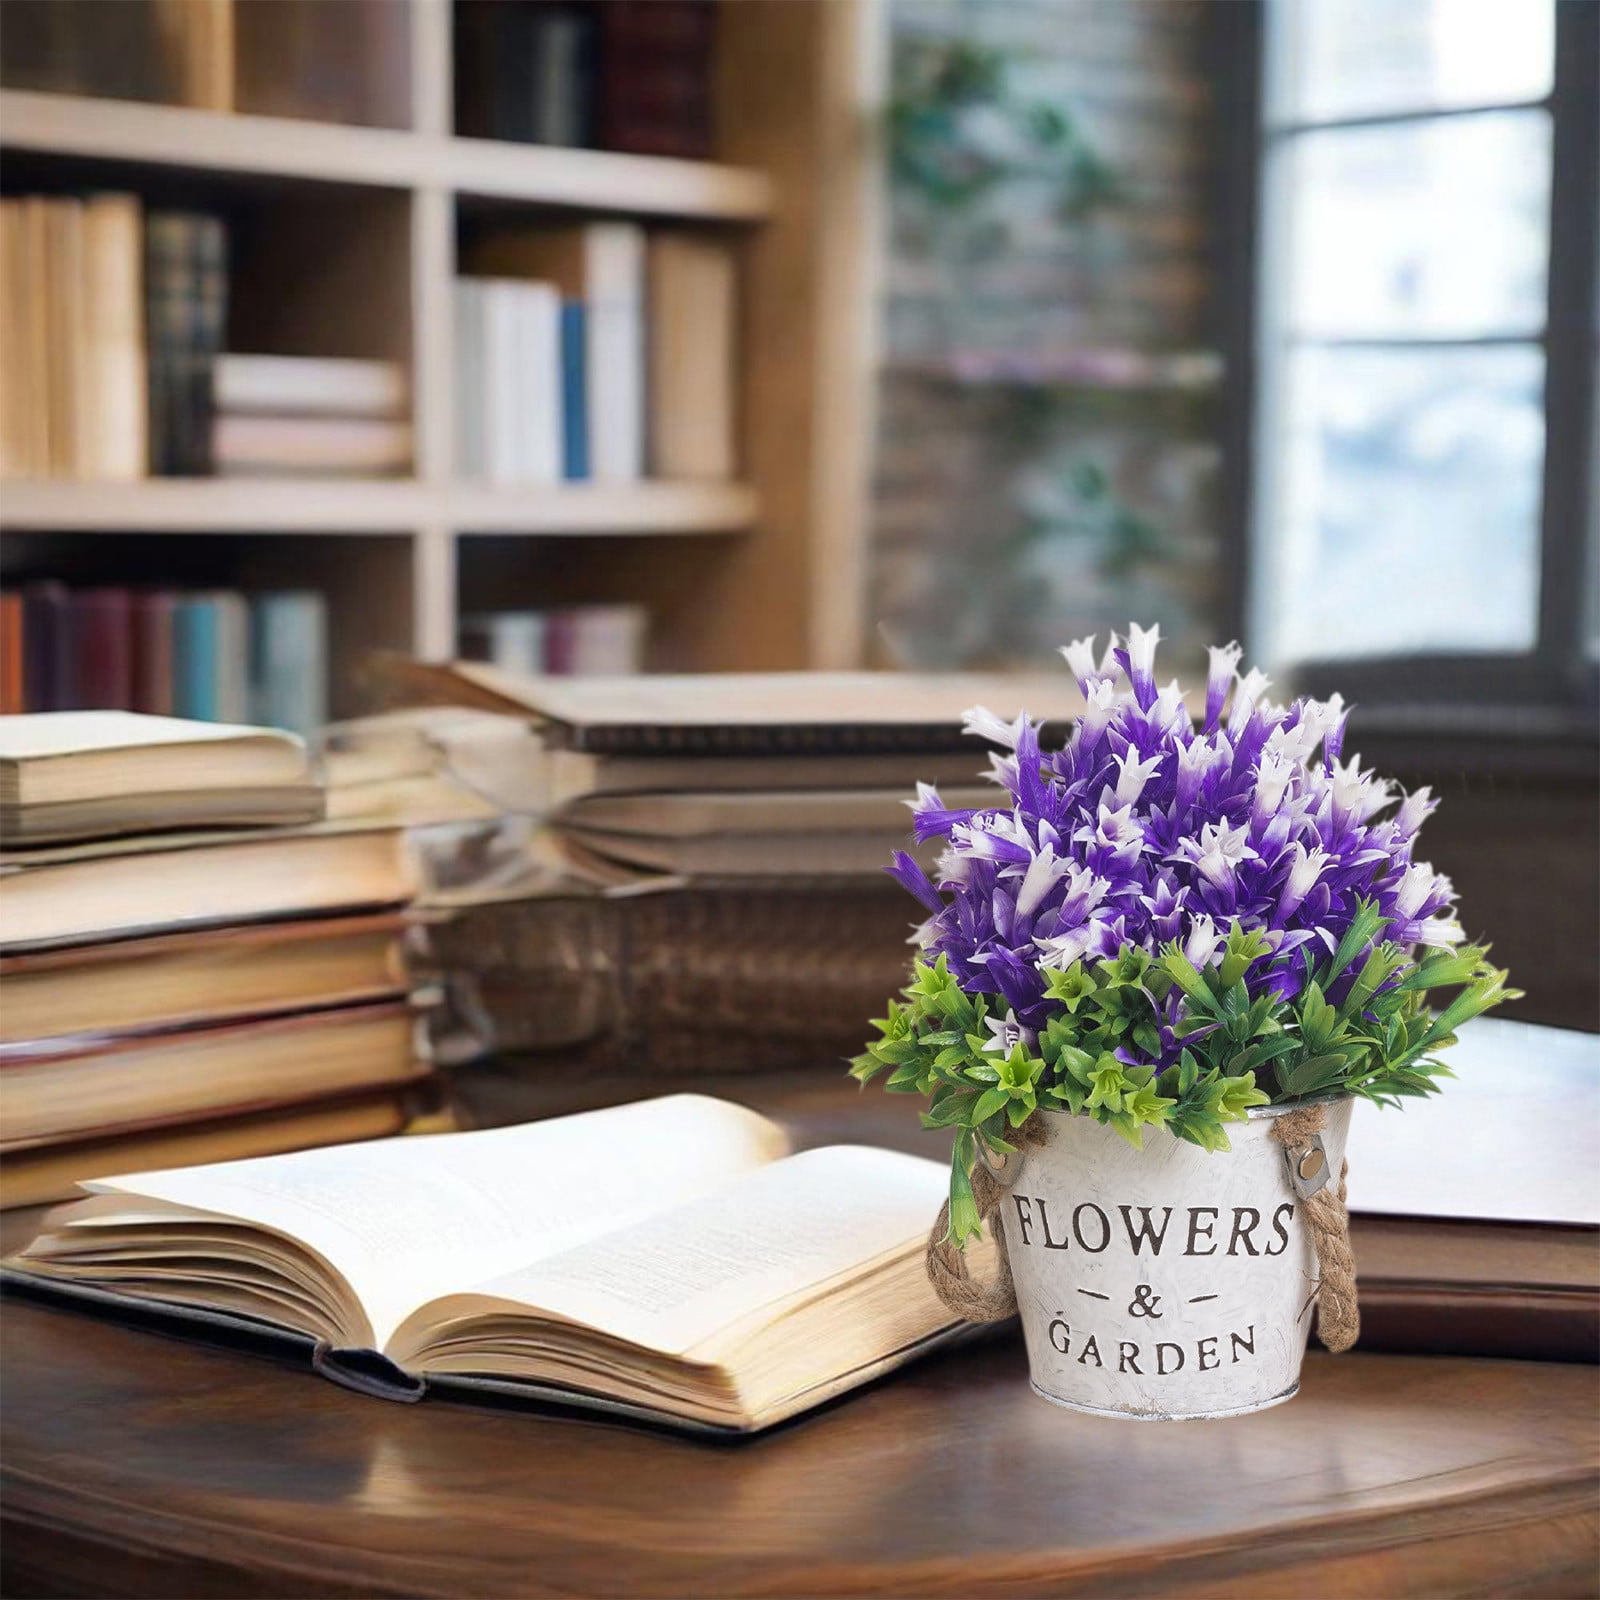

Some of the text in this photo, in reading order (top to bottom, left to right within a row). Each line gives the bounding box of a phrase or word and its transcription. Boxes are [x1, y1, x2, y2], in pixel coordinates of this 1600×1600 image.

[1012, 1194, 1295, 1256] FLOWERS
[1128, 1284, 1163, 1319] &
[1049, 1319, 1255, 1375] GARDEN
